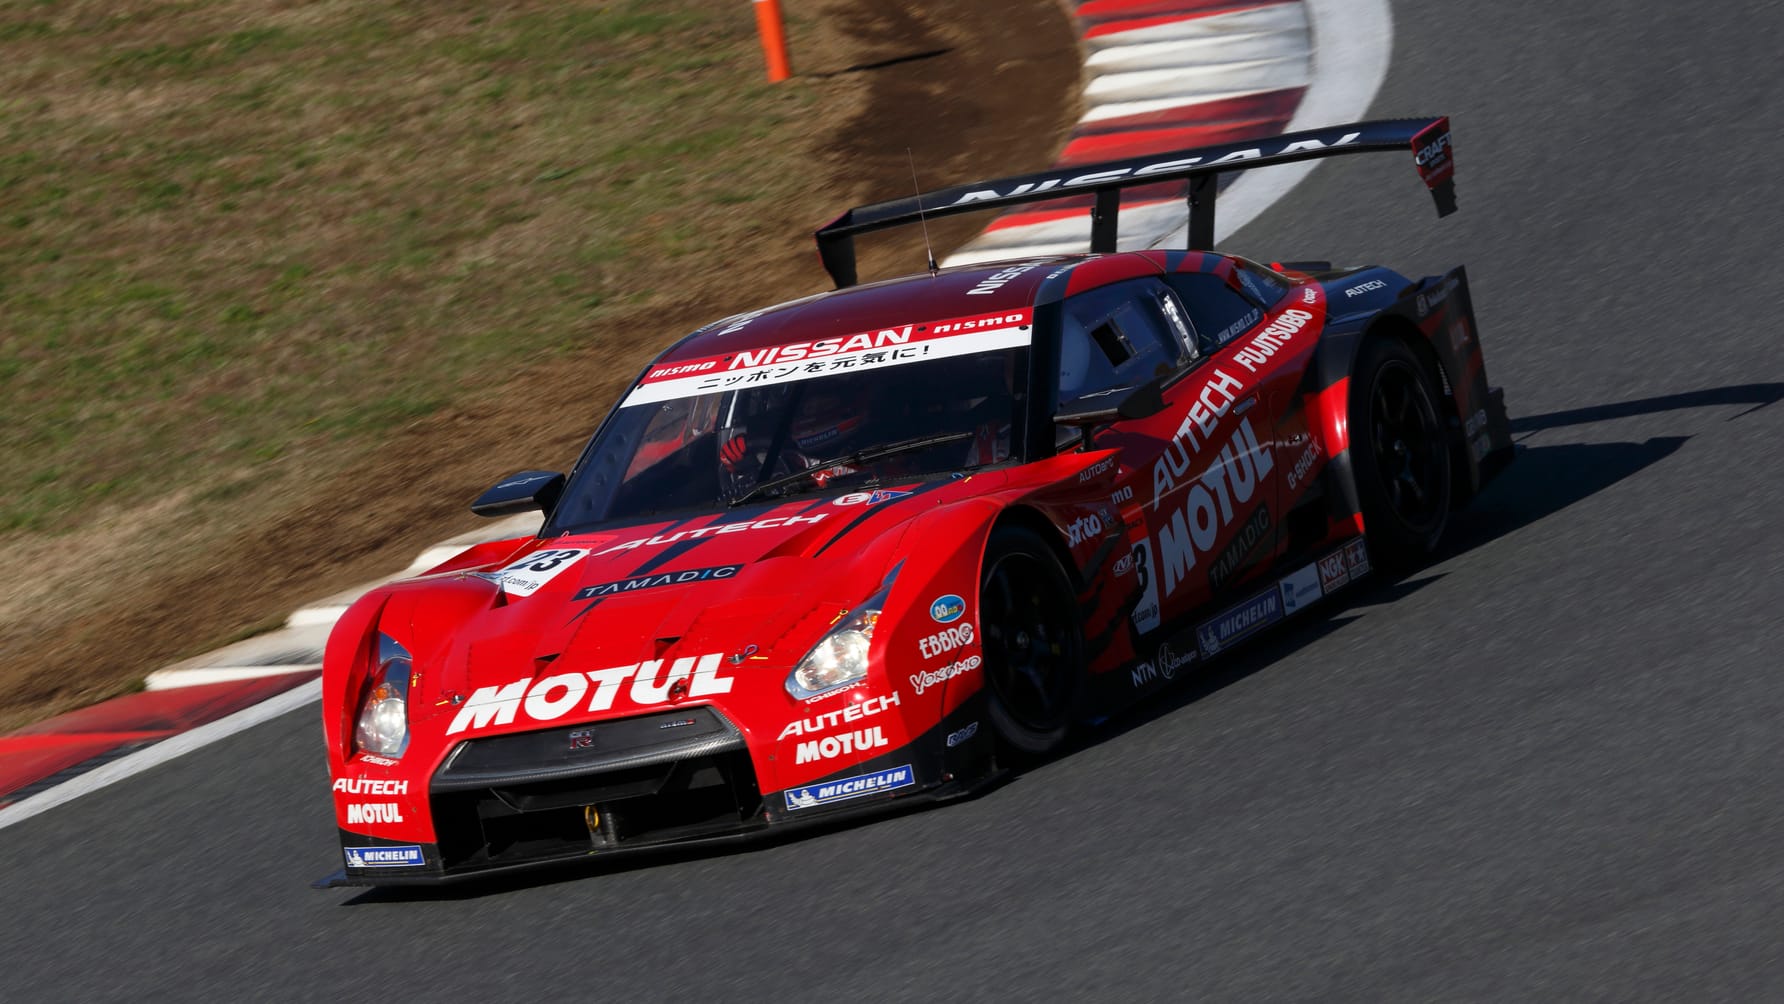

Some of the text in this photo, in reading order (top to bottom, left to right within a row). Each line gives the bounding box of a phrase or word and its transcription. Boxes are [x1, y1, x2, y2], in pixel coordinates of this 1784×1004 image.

[1345, 280, 1387, 298] AUTECH
[728, 326, 913, 370] NISSAN
[933, 313, 1023, 334] nismo
[1233, 308, 1314, 373] FUJITSUBO
[1153, 368, 1243, 512] AUTECH
[1158, 416, 1274, 598] MOTUL
[593, 513, 829, 557] AUTECH
[505, 549, 581, 572] 23
[585, 567, 736, 597] TAMADIC
[1220, 596, 1277, 640] MICHELIN
[919, 623, 974, 659] EBBRO
[1131, 659, 1158, 688] NTN
[445, 652, 736, 736] MOTUL
[777, 690, 900, 741] AUTECH
[796, 726, 888, 765] MOTUL
[333, 778, 408, 795] AUTECH
[818, 770, 906, 798] MICHELIN
[347, 803, 403, 824] MOTUL
[364, 850, 418, 861] MICHELIN
